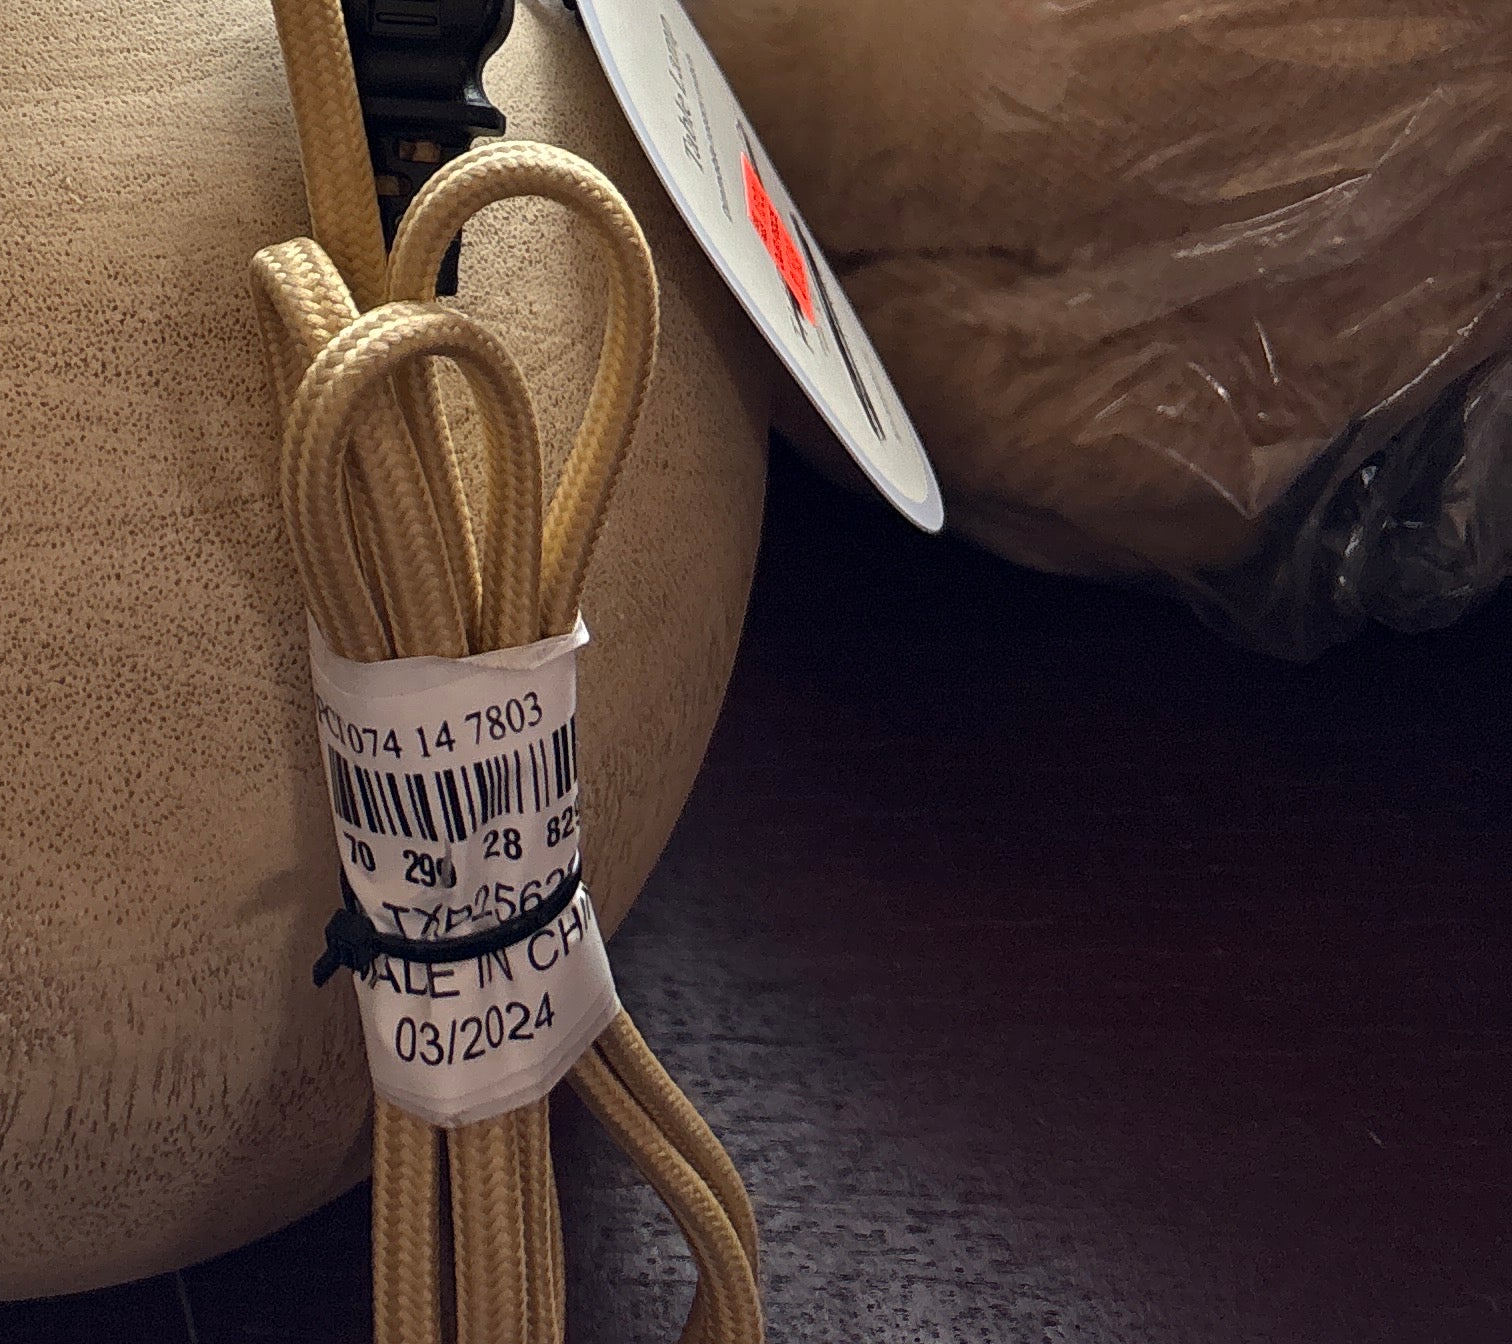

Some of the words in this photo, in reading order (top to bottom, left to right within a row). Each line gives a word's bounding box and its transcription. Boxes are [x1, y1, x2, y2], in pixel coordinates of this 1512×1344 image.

[416, 720, 456, 758] 14
[464, 691, 543, 745] 7803
[343, 831, 377, 872] 70
[483, 828, 523, 861] 28
[547, 796, 580, 847] 82
[395, 991, 555, 1066] 03/2024
